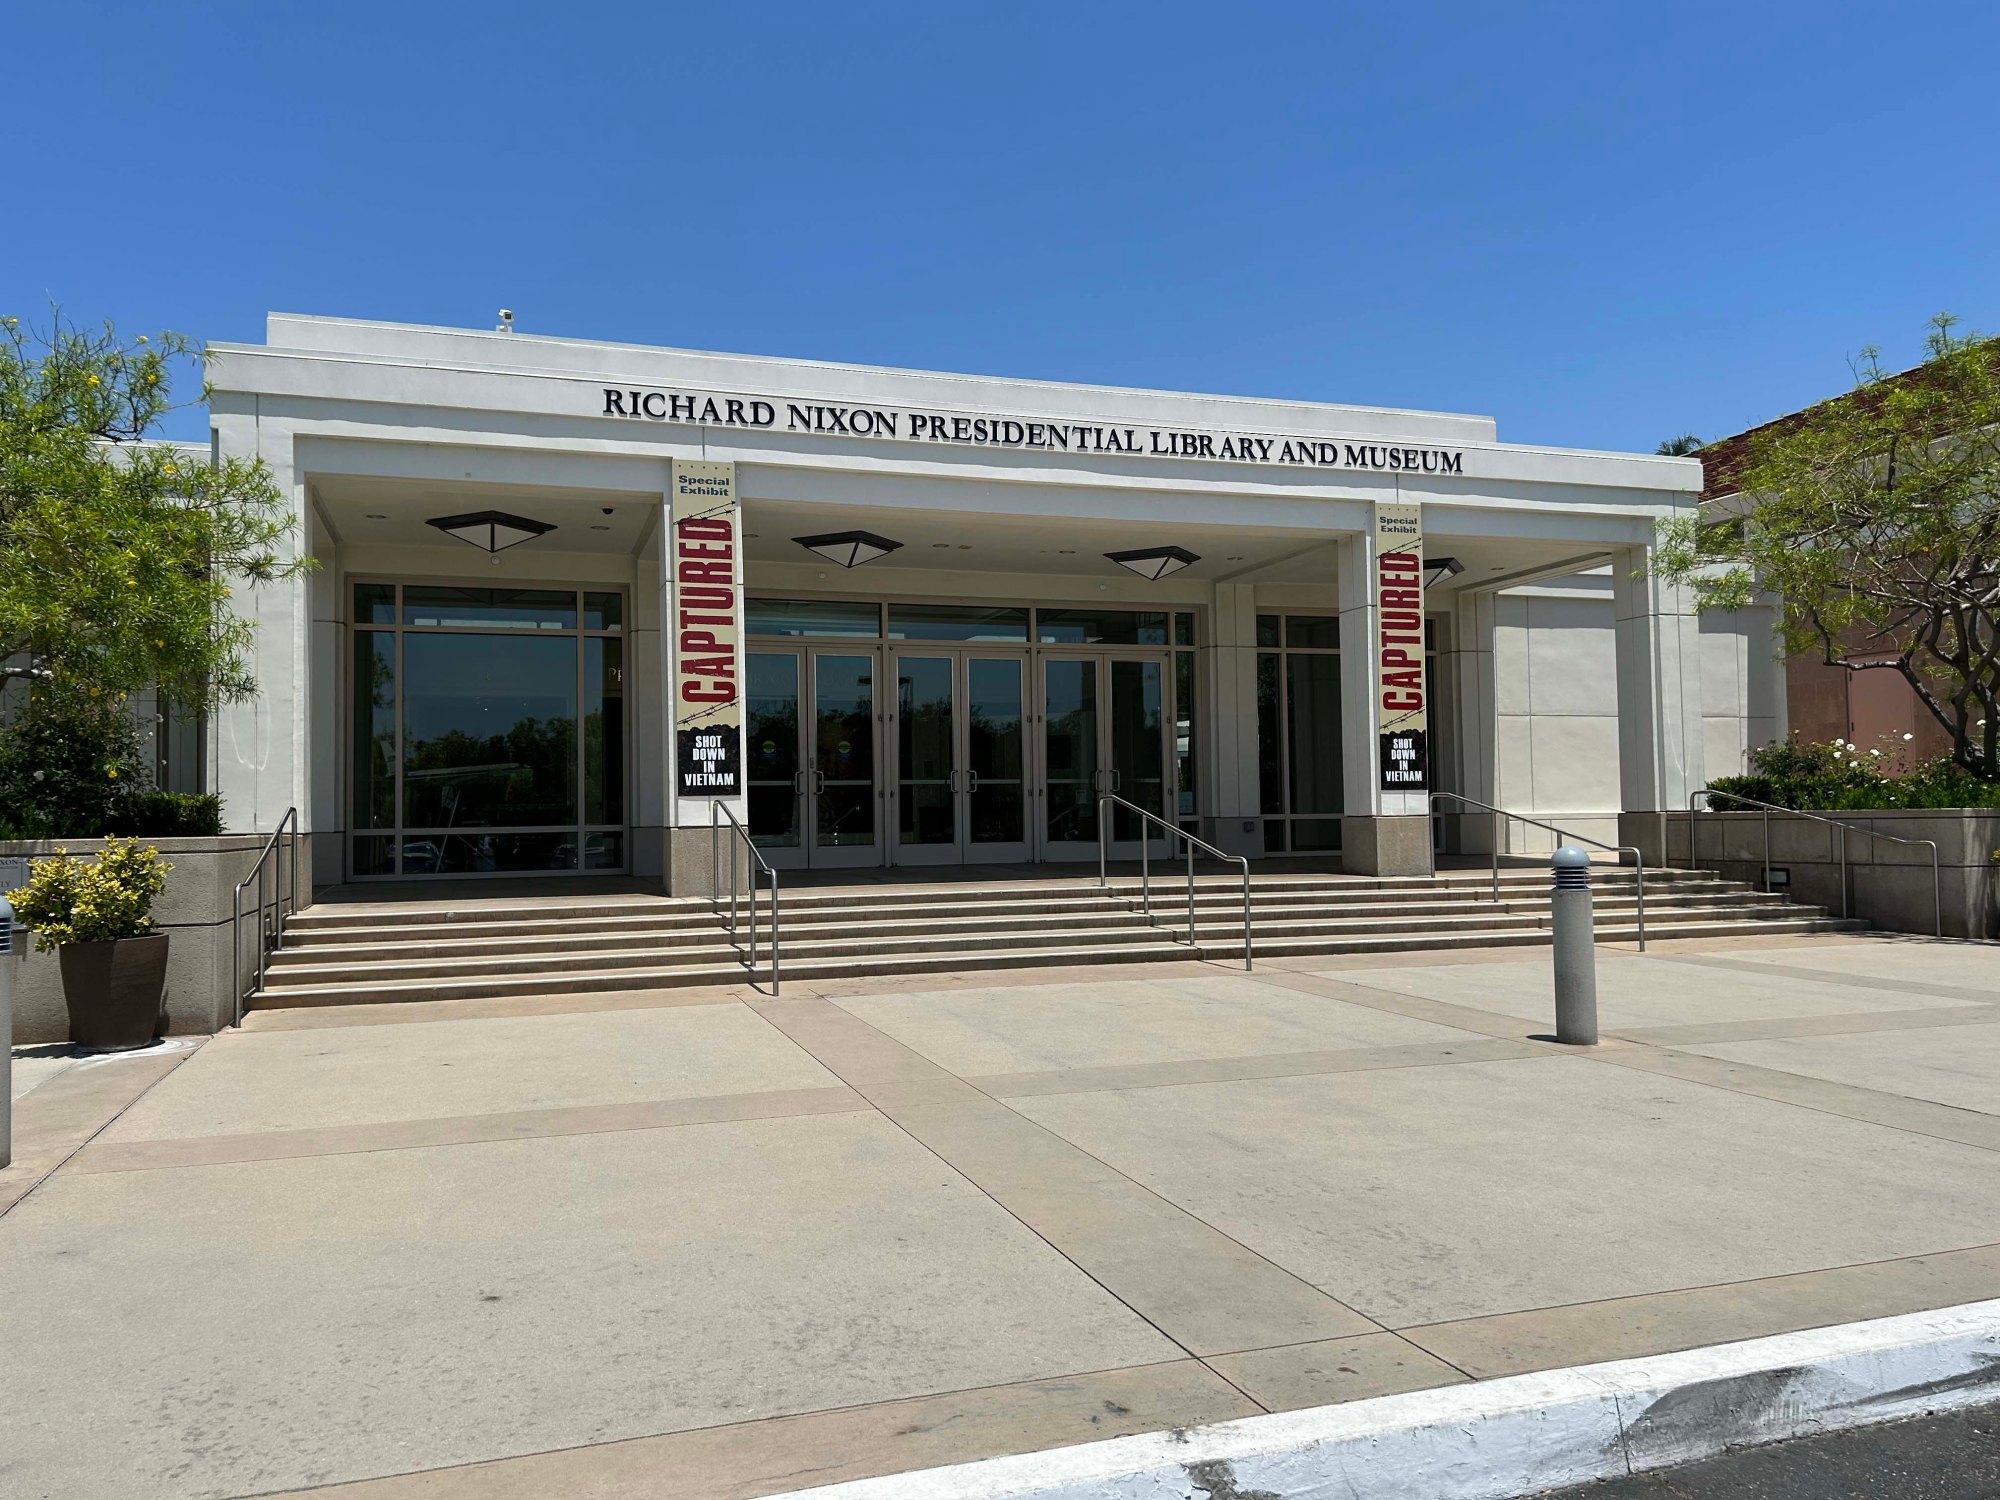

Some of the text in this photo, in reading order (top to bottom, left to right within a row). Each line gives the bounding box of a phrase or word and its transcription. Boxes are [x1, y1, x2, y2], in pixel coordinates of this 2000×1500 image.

[603, 388, 1463, 473] RICHARD NIXON PRESIDENTIAL LIBRARY AND MUSEUM
[678, 474, 730, 486] Special
[680, 485, 729, 497] Exhibit
[1379, 516, 1418, 525] Special
[1381, 525, 1417, 534] Exhibit
[678, 517, 736, 703] CAPTURED
[1379, 552, 1423, 711] CAPTURED
[695, 735, 722, 748] SHOT
[1392, 738, 1413, 749] SHOT
[692, 748, 726, 761] DOWN
[1391, 749, 1416, 760] DOWN
[703, 760, 716, 773] IN
[1399, 760, 1409, 771] IN
[684, 773, 734, 786] VIETNAM
[1385, 770, 1423, 782] VIETNAM
